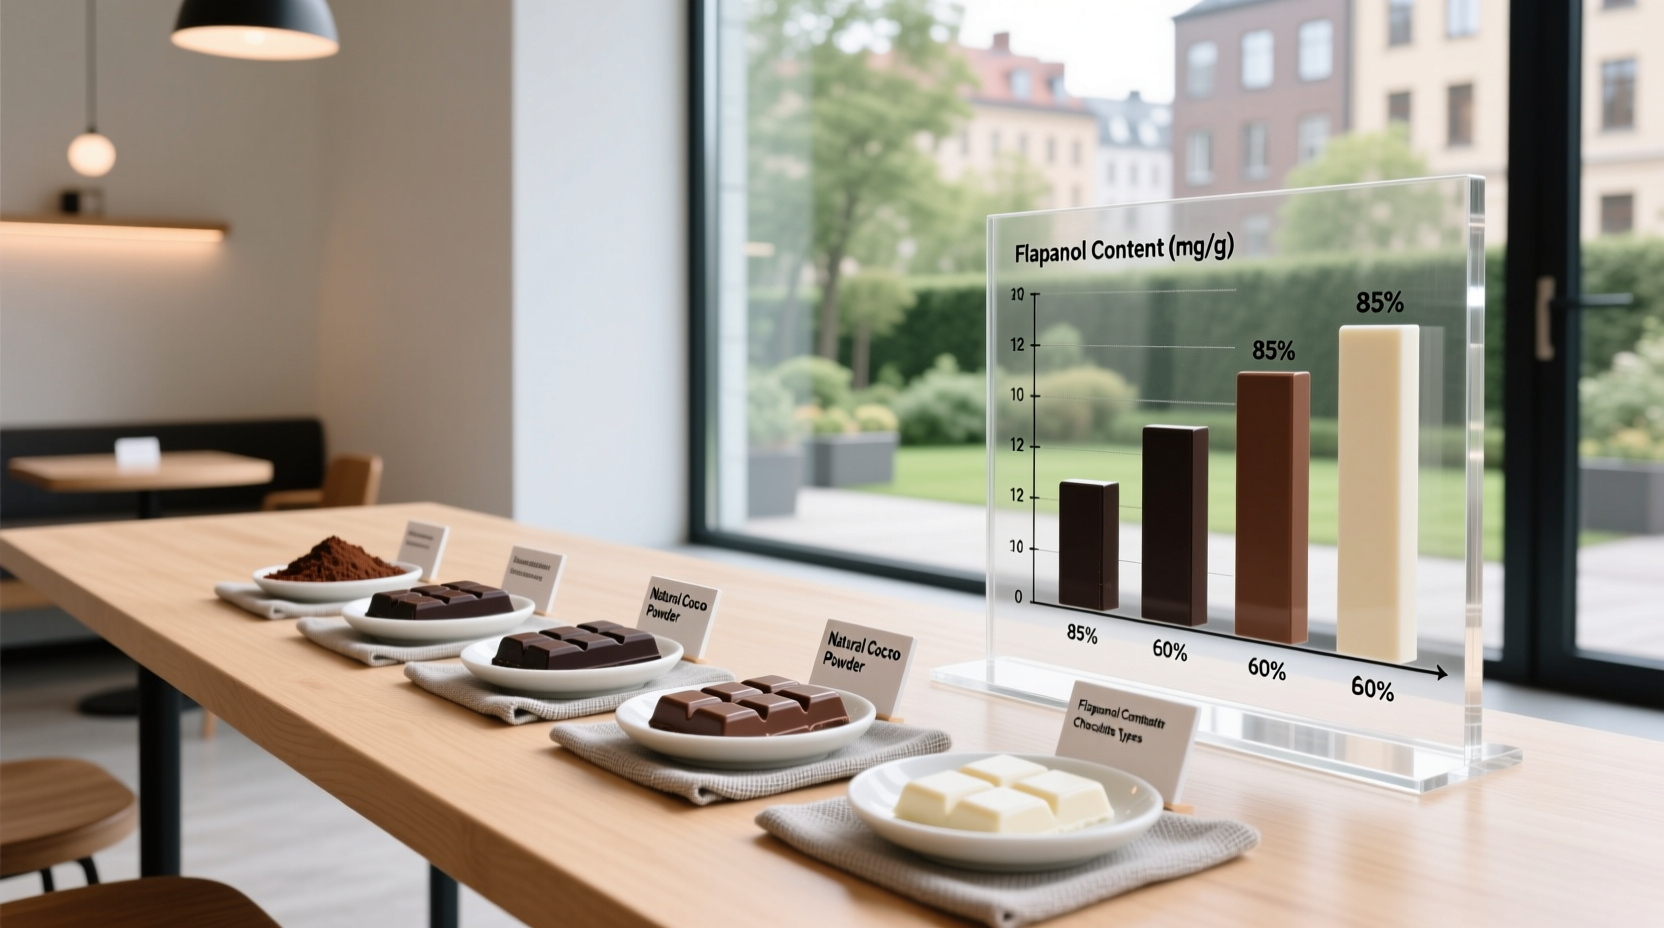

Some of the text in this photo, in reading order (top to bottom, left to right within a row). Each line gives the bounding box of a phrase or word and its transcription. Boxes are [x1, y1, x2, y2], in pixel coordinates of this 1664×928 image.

[1015, 231, 1235, 268] Flapanol Content (mg/g)
[1356, 290, 1405, 314] 85%
[1010, 337, 1025, 351] 12
[1252, 339, 1296, 361] 85%
[1010, 387, 1024, 401] 10
[1010, 437, 1025, 451] 12
[1010, 487, 1024, 502] 12
[1014, 589, 1023, 603] 0
[1067, 623, 1098, 645] 85%
[823, 650, 866, 673] Powder
[1152, 639, 1188, 662] 60%
[1248, 657, 1287, 681] 60%
[1351, 675, 1395, 702] 60%
